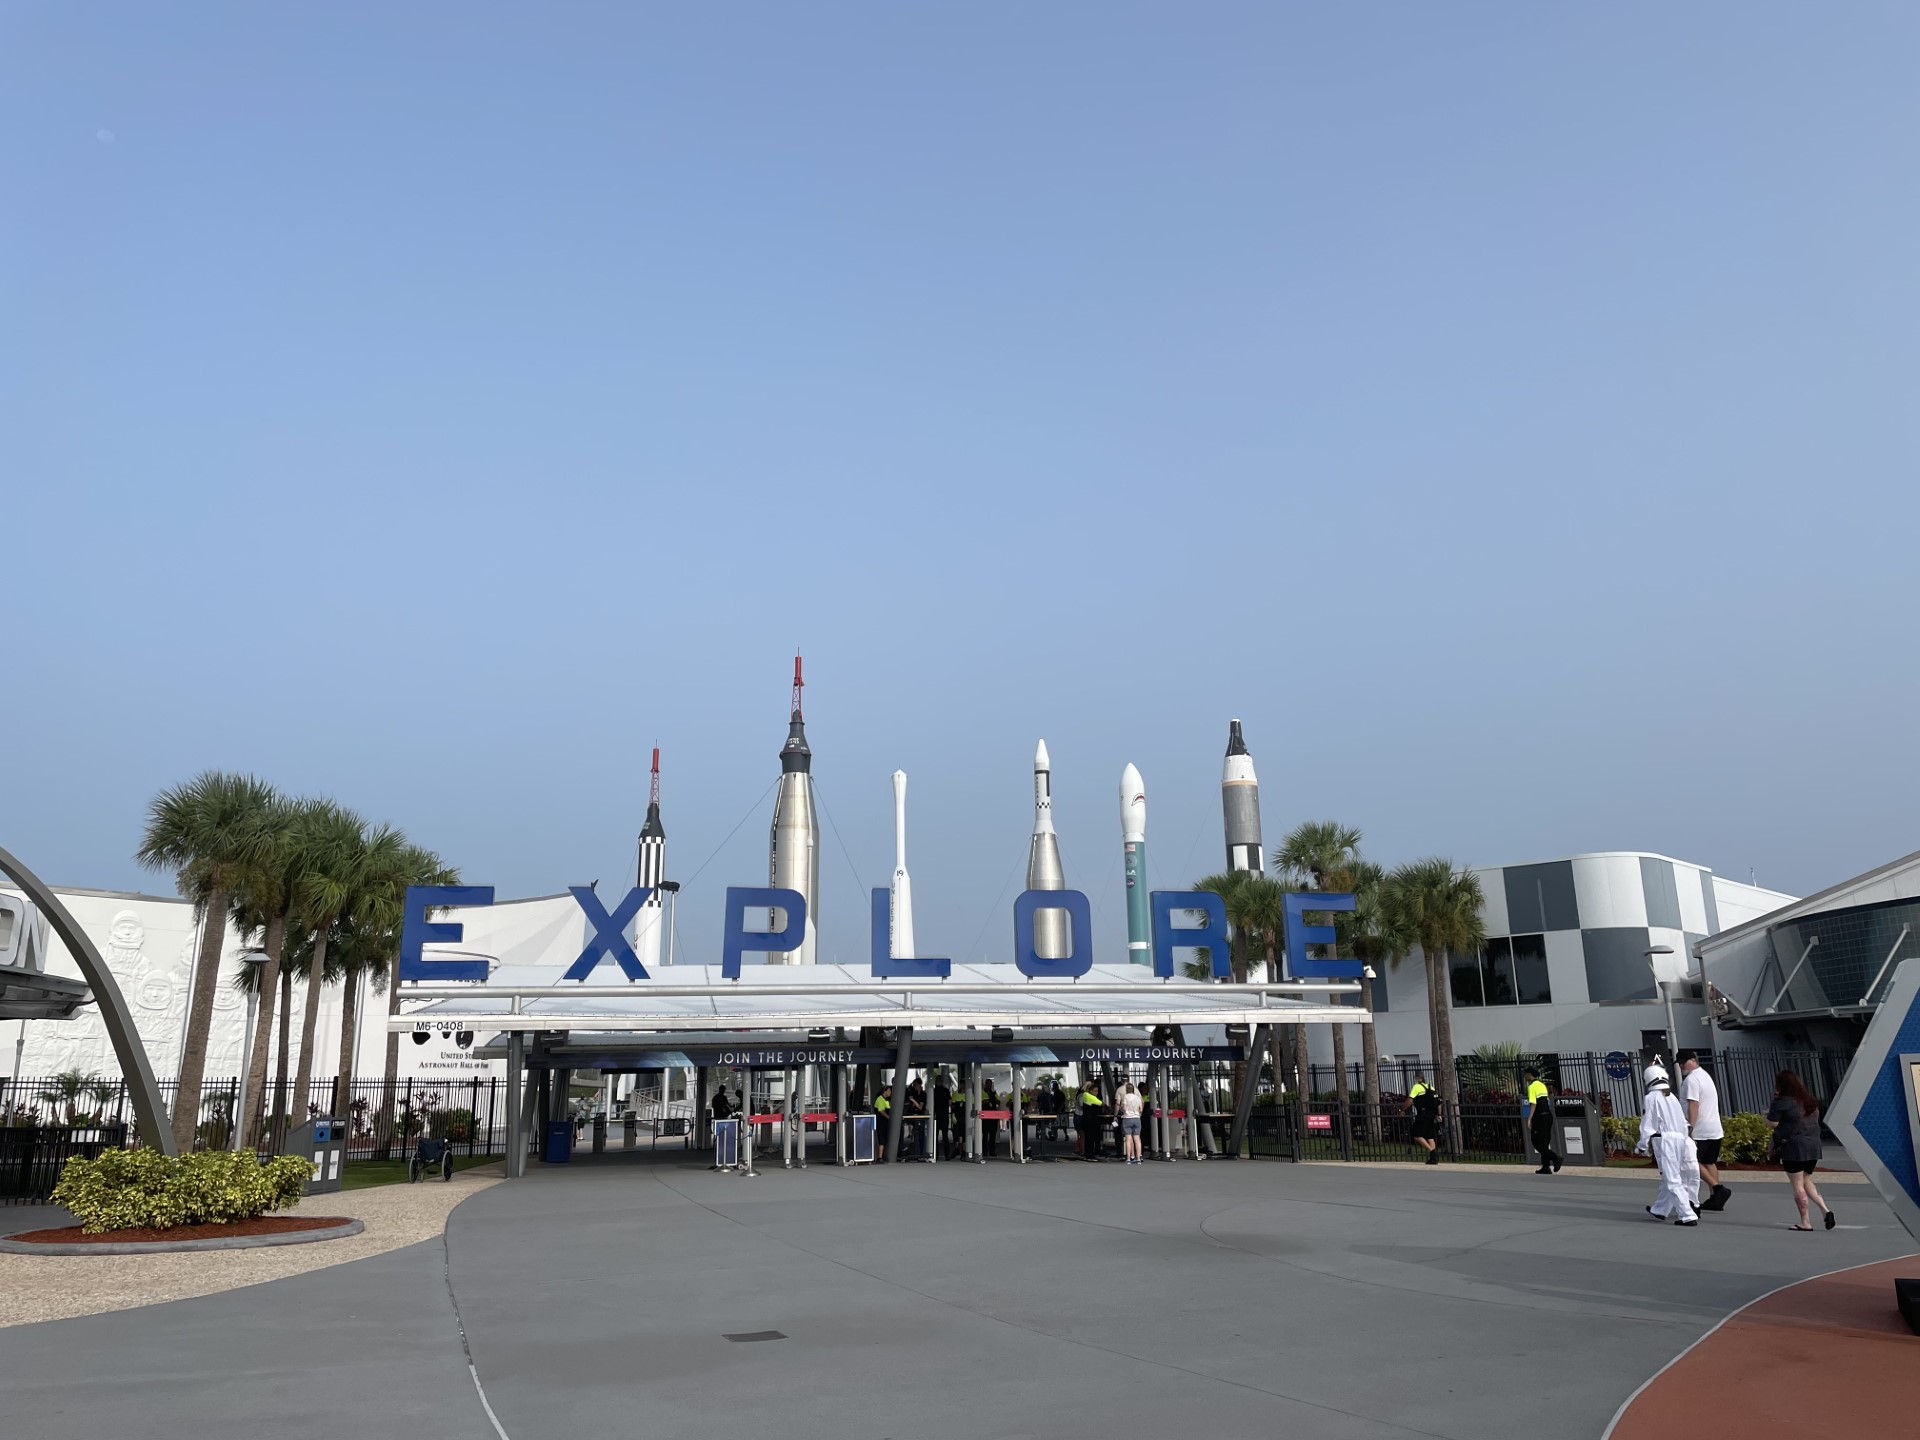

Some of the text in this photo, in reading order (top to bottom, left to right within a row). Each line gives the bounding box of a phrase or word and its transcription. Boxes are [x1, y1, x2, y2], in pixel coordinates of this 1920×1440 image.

[399, 885, 1363, 981] EXPLORE
[415, 1021, 464, 1031] M6-0408
[717, 1050, 854, 1064] JOIN THE JOURNEY
[1080, 1047, 1204, 1059] JOIN THE JOURNEY
[418, 1061, 458, 1069] ASTRONAUT
[460, 1061, 473, 1069] HALL
